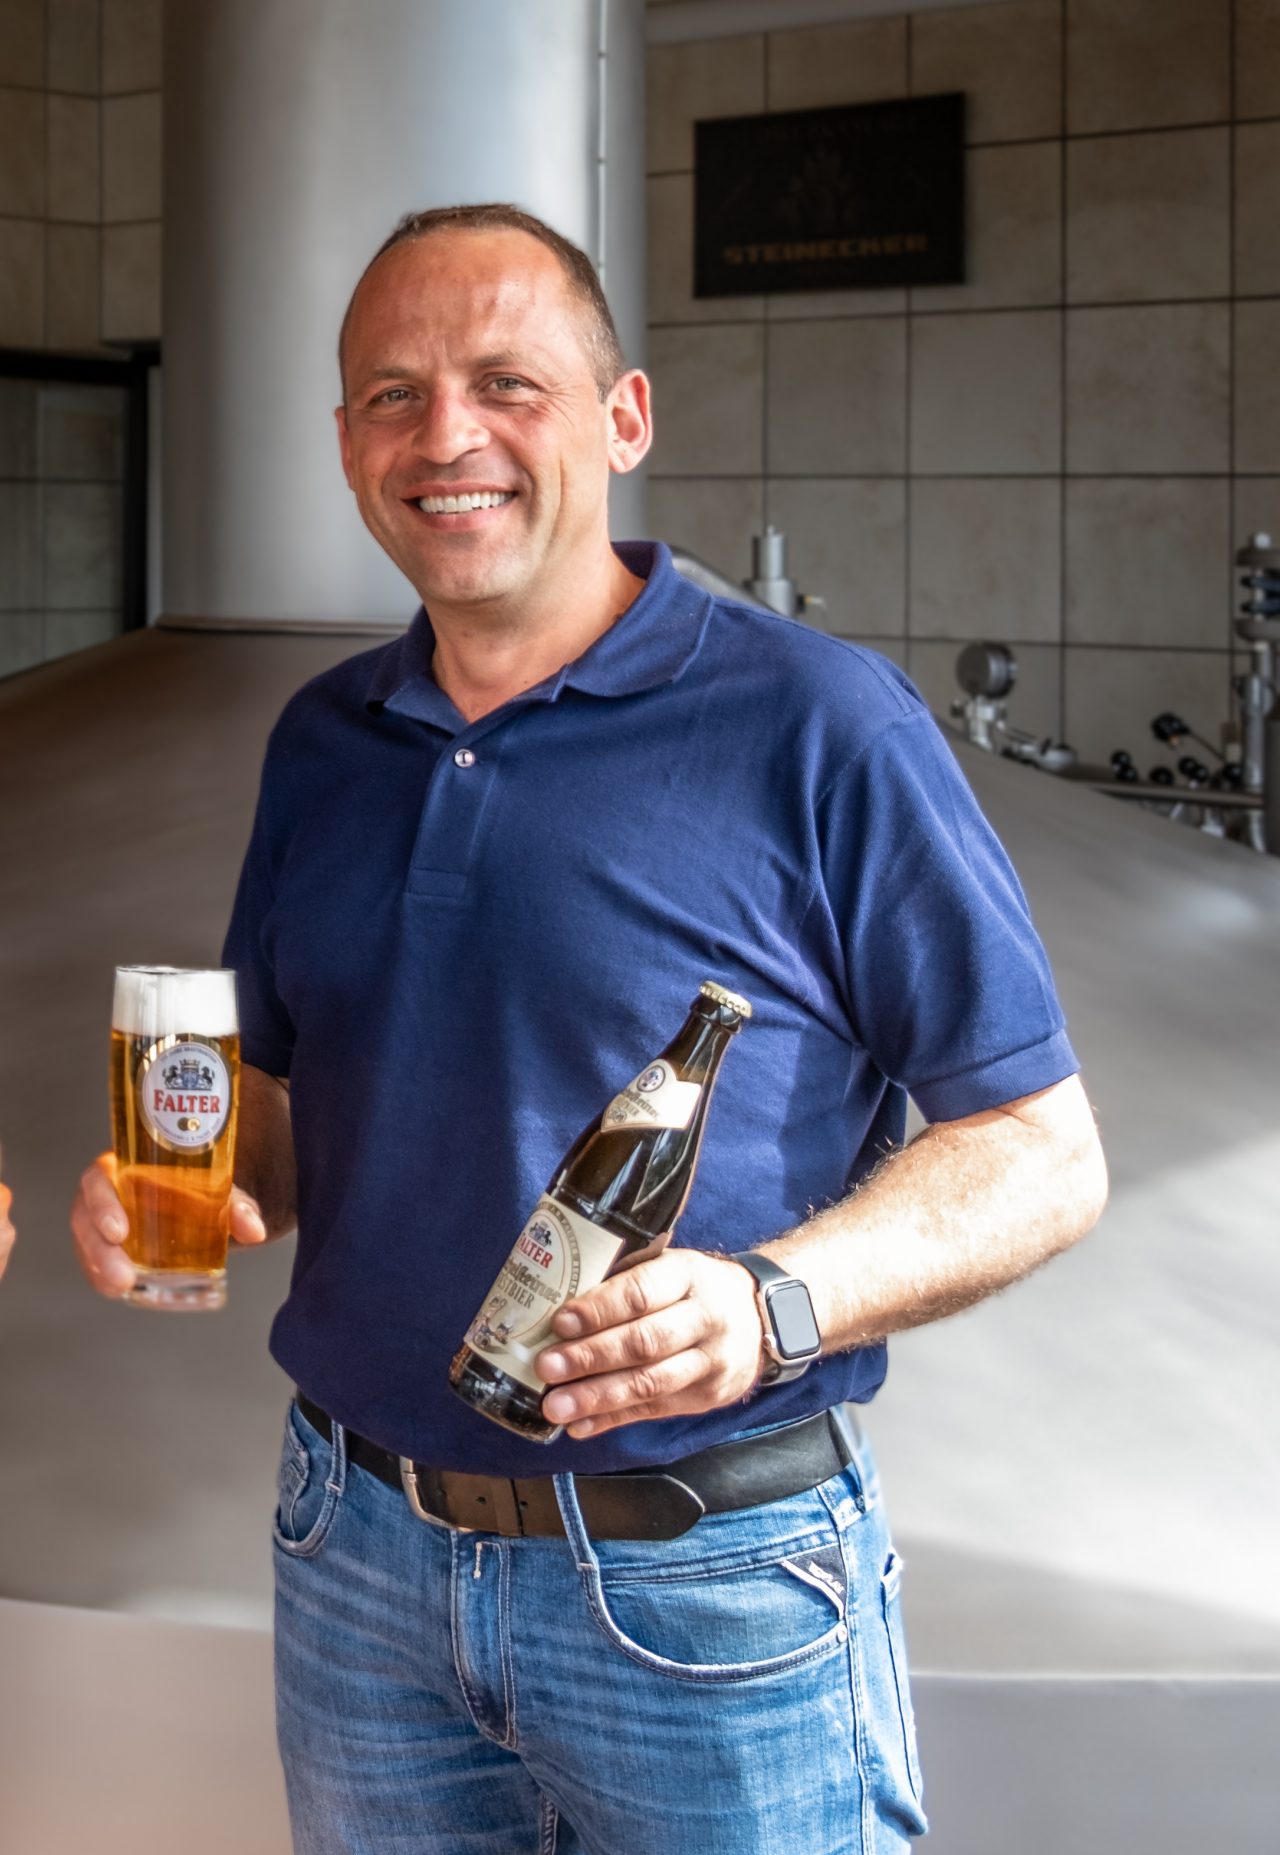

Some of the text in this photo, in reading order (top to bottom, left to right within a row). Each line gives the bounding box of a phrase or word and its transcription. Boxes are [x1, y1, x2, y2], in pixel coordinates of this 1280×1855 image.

[723, 234, 928, 265] STEINECKER
[153, 1089, 221, 1113] FALTER
[517, 1235, 553, 1269] ALTER
